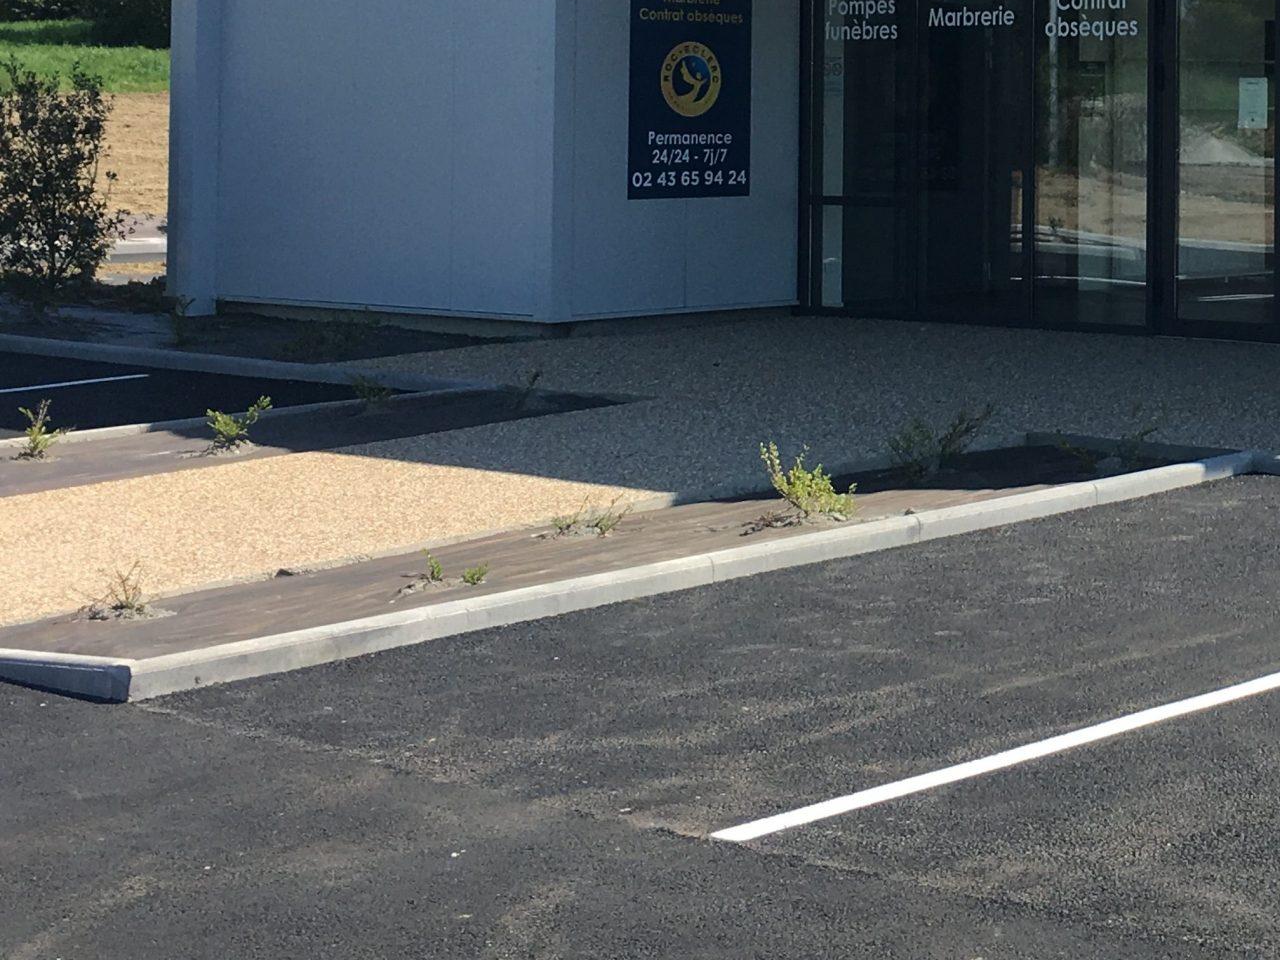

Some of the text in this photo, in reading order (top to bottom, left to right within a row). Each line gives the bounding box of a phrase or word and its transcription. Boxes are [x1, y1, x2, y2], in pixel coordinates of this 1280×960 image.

[639, 8, 685, 21] Contrat
[928, 5, 1015, 27] Marbrerie
[824, 19, 898, 40] funèbres
[1045, 14, 1138, 41] obsèques
[648, 131, 733, 145] Permanence
[652, 149, 690, 166] 24/24
[703, 148, 728, 166] 7j/7
[632, 169, 747, 188] 02 43 65 94 24
